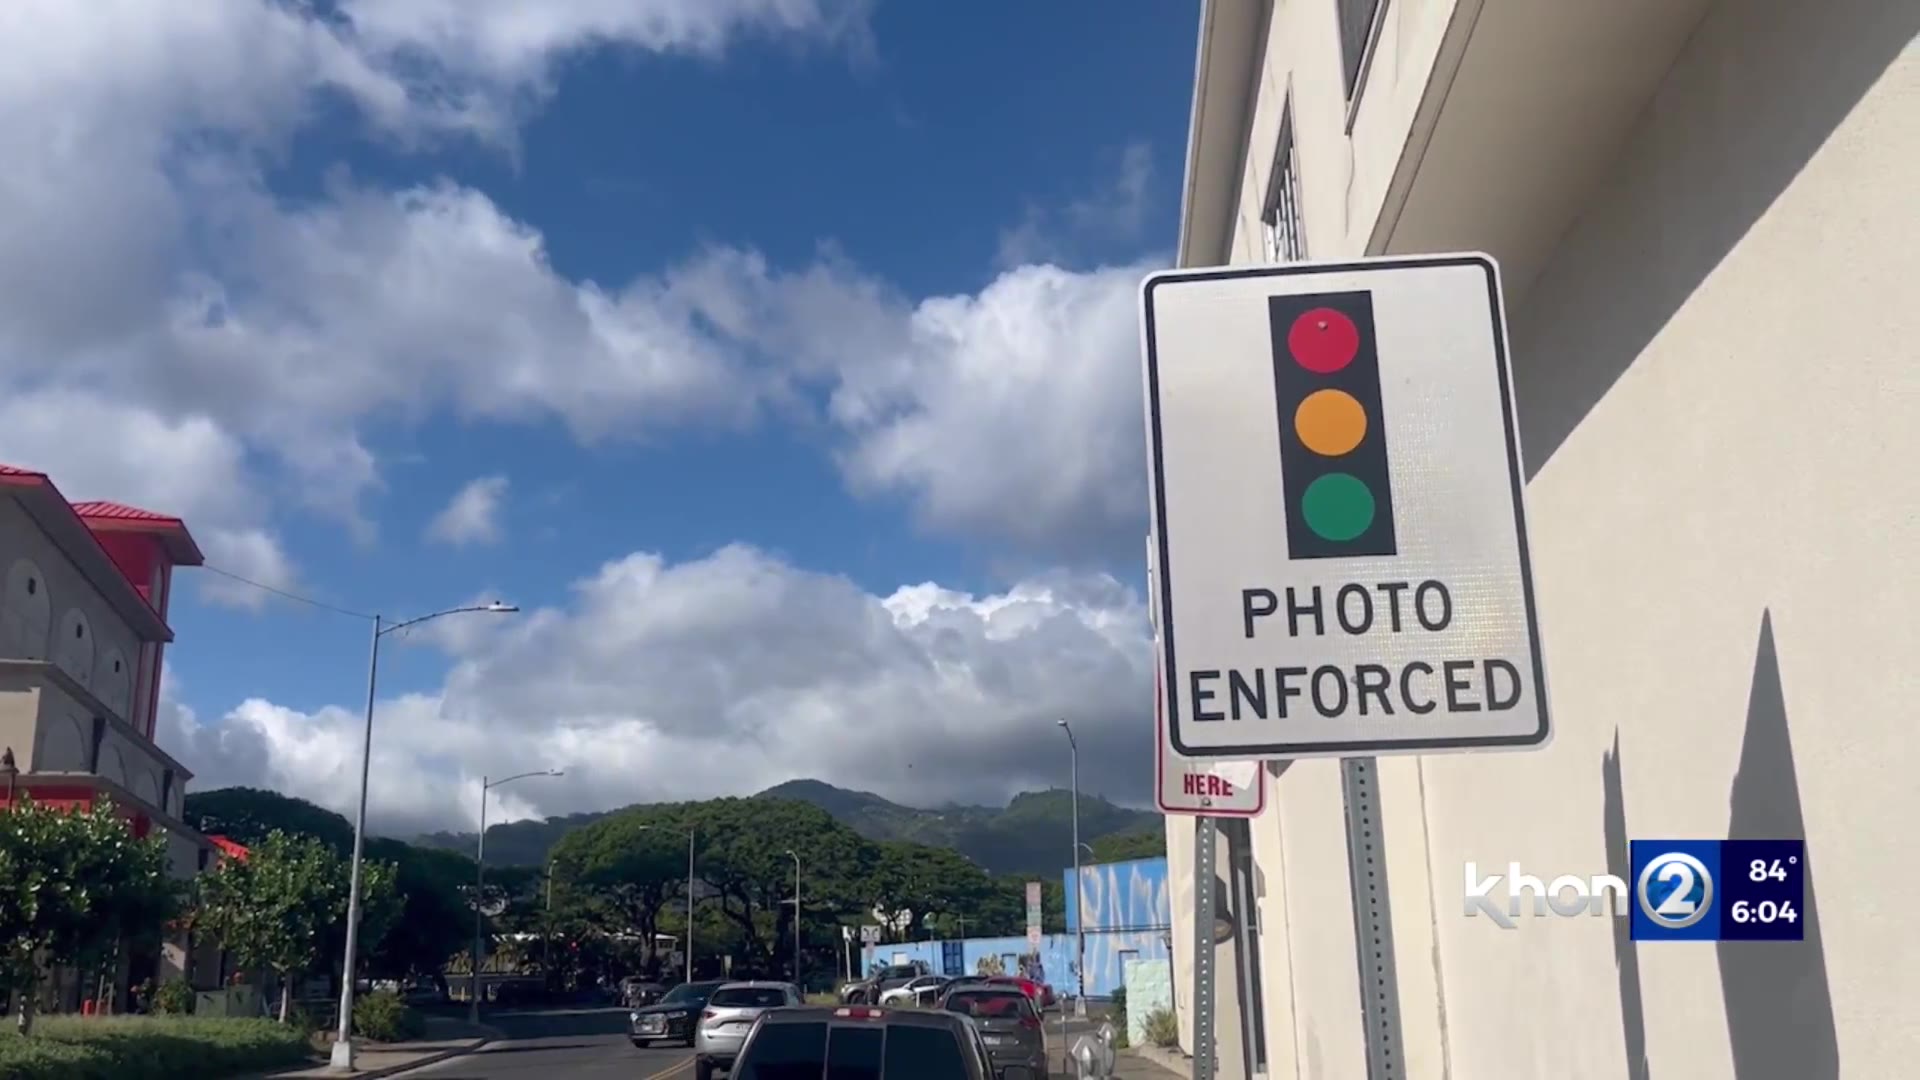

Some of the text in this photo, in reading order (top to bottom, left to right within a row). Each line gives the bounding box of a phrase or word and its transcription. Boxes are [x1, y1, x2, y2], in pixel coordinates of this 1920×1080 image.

[1242, 579, 1452, 639] PHOTO
[1189, 659, 1523, 722] ENFORCED
[1183, 773, 1233, 796] HERE
